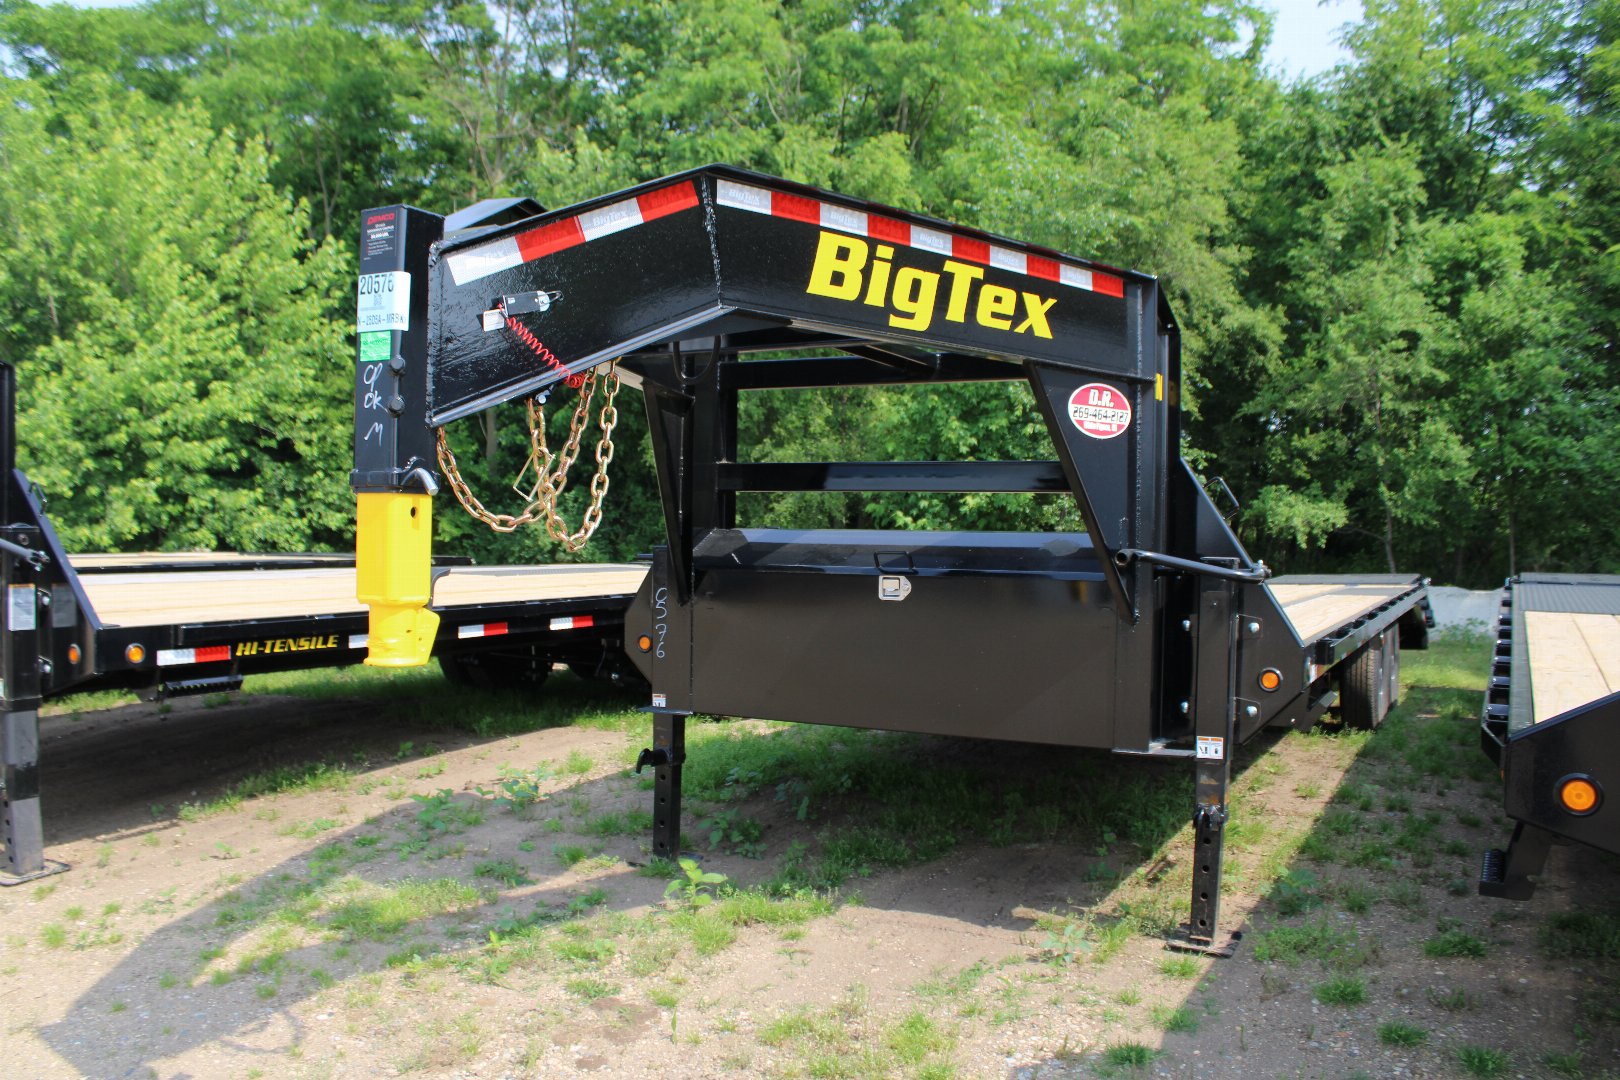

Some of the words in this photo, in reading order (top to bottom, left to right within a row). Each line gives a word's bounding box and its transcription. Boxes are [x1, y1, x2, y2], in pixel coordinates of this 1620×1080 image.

[360, 273, 394, 295] 20576
[806, 231, 1058, 339] BigTex
[1088, 388, 1115, 408] D.R.
[235, 634, 339, 656] HI-TENSILE
